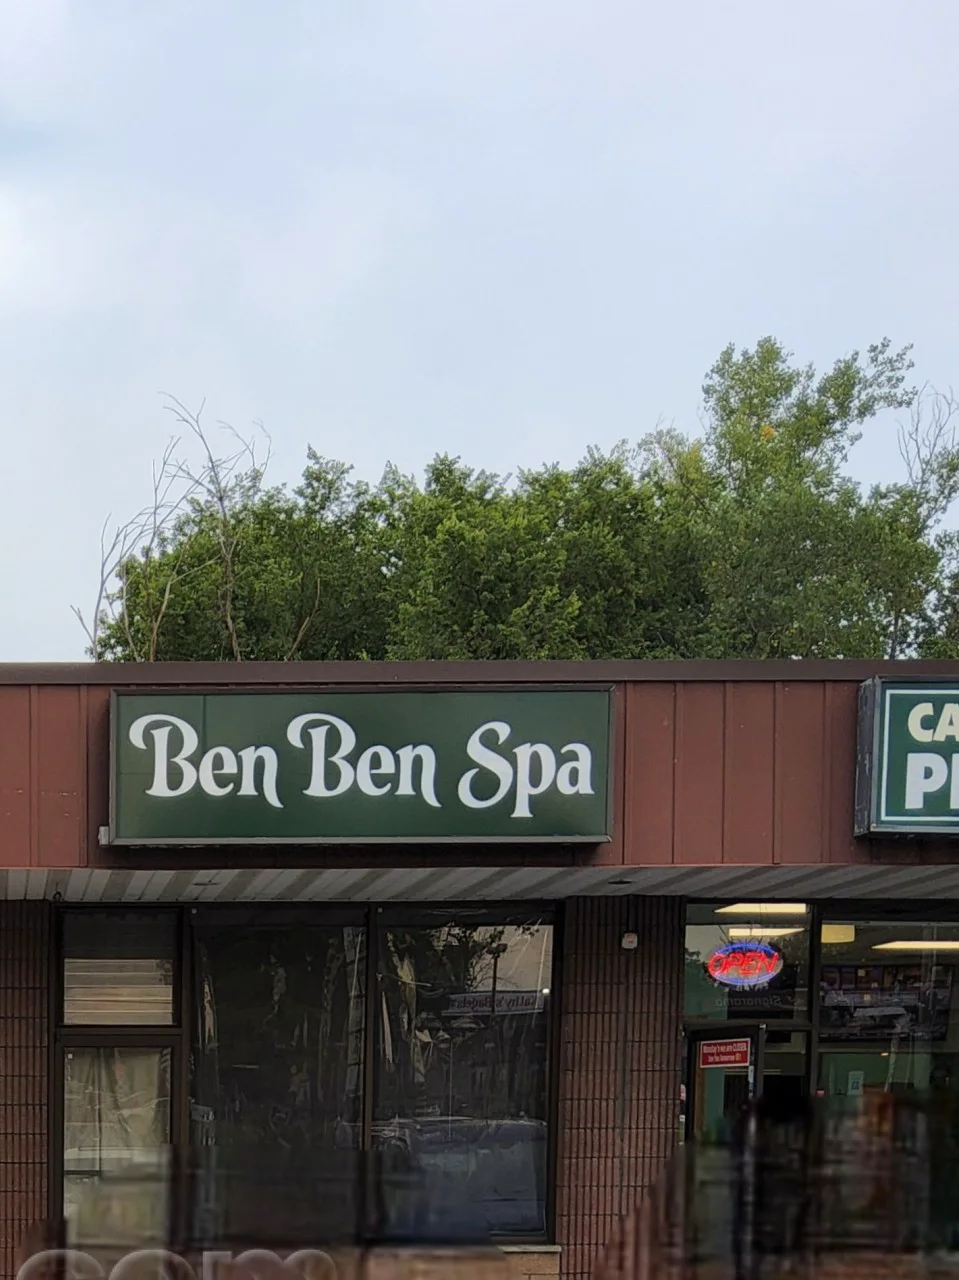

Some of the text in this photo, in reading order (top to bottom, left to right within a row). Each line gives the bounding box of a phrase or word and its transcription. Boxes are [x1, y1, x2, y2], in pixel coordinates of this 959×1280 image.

[128, 712, 595, 818] Ben Ben Spa
[904, 752, 959, 810] P
[708, 951, 780, 976] OPEN
